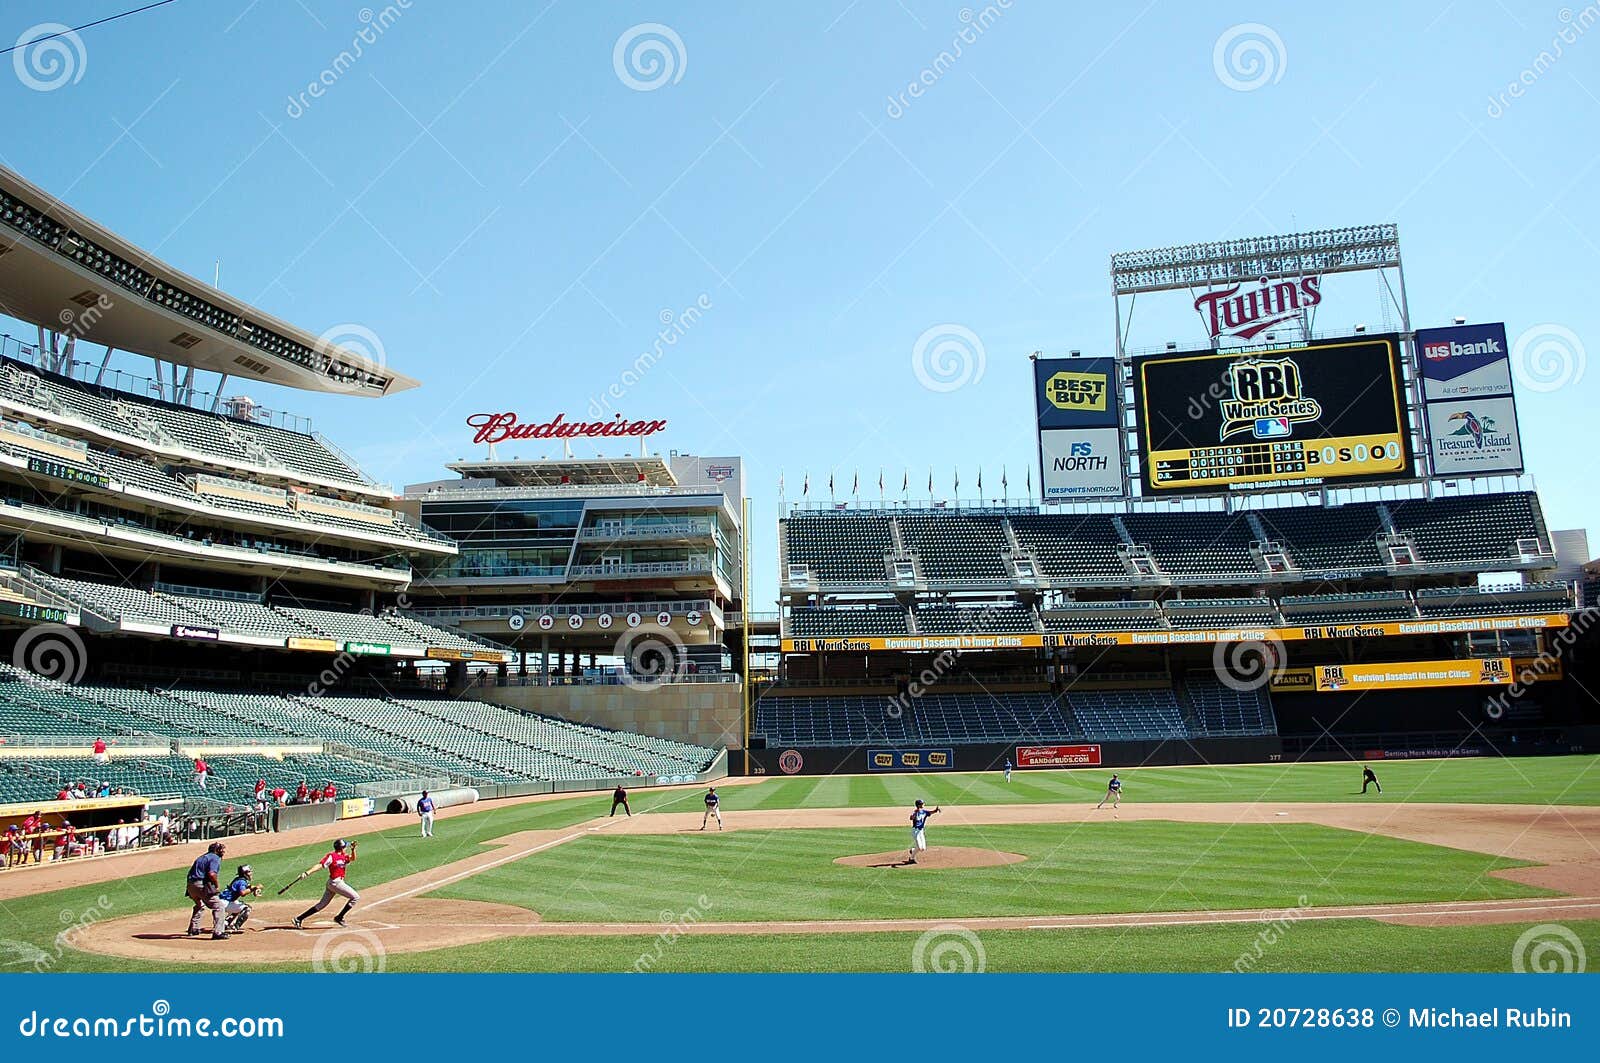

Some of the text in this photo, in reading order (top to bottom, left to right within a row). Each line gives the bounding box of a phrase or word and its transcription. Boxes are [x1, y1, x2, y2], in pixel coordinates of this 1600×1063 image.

[1194, 276, 1322, 339] Twins
[1053, 379, 1105, 393] BEST
[1236, 364, 1300, 401] RBI
[1055, 391, 1100, 405] BUY
[466, 412, 667, 444] Budweiser
[1274, 442, 1302, 451] R H E
[1437, 433, 1511, 450] Treasure Island
[1071, 442, 1092, 457] FS
[1307, 450, 1320, 464] B
[1321, 446, 1336, 465] 0
[1339, 448, 1352, 462] S
[1353, 443, 1368, 462] 0
[1385, 441, 1400, 460] 0
[1053, 456, 1108, 471] NORTH
[1191, 459, 1197, 467] 0
[1210, 458, 1215, 466] 1
[1219, 457, 1225, 465] 1
[1227, 457, 1233, 465] 0
[1236, 456, 1243, 464] 0
[1157, 467, 1235, 480] D.R. 0 0 1 1 3
[512, 619, 520, 627] 42
[571, 618, 580, 626] 34
[601, 617, 609, 625] 14
[1400, 623, 1438, 633] Reviving
[1440, 620, 1480, 631] Baseball
[1492, 619, 1517, 628] Inner
[1518, 617, 1546, 627] Cities
[1132, 633, 1168, 644] Reviving
[1170, 632, 1206, 642] Baseball
[1217, 631, 1240, 641] Inner
[1240, 630, 1265, 640] Cities
[1304, 628, 1323, 639] RBI
[793, 640, 810, 651] RBI
[885, 639, 922, 649] Reviving
[924, 638, 960, 648] Baseball
[973, 638, 996, 647] Inner
[997, 637, 1022, 647] Cities
[1042, 635, 1059, 646] RBI
[1484, 660, 1504, 671] RBI
[1325, 667, 1344, 678] RBI
